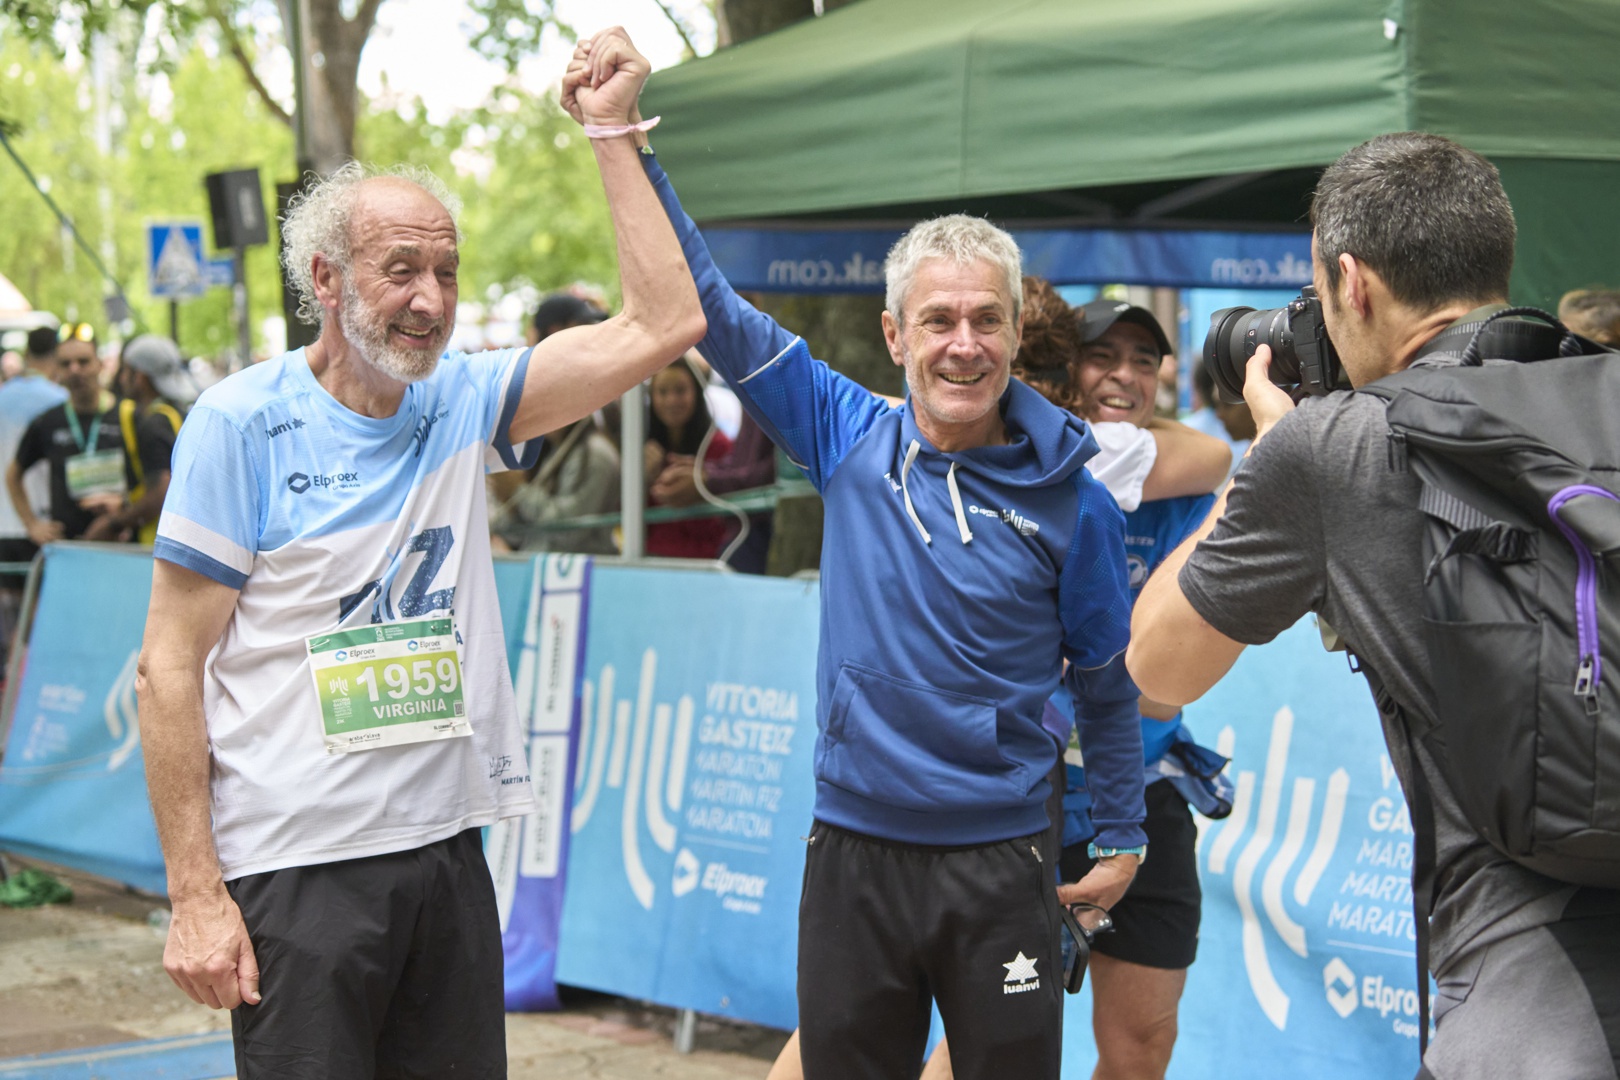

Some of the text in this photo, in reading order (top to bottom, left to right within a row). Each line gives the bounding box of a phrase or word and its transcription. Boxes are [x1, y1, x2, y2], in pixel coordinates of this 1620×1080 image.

[313, 471, 358, 489] Elproex
[349, 648, 375, 658] Elproex
[419, 640, 441, 648] Elproex
[356, 657, 459, 702] 1959
[373, 698, 447, 719] VIRGINIA
[706, 682, 799, 722] VITORIA
[698, 716, 796, 755] GASTEIZ
[501, 775, 524, 785] MARTÍN
[1368, 796, 1415, 836] GA
[1339, 870, 1414, 905] MARTI
[1003, 979, 1040, 995] luanvi
[1362, 975, 1435, 1018] Elpro
